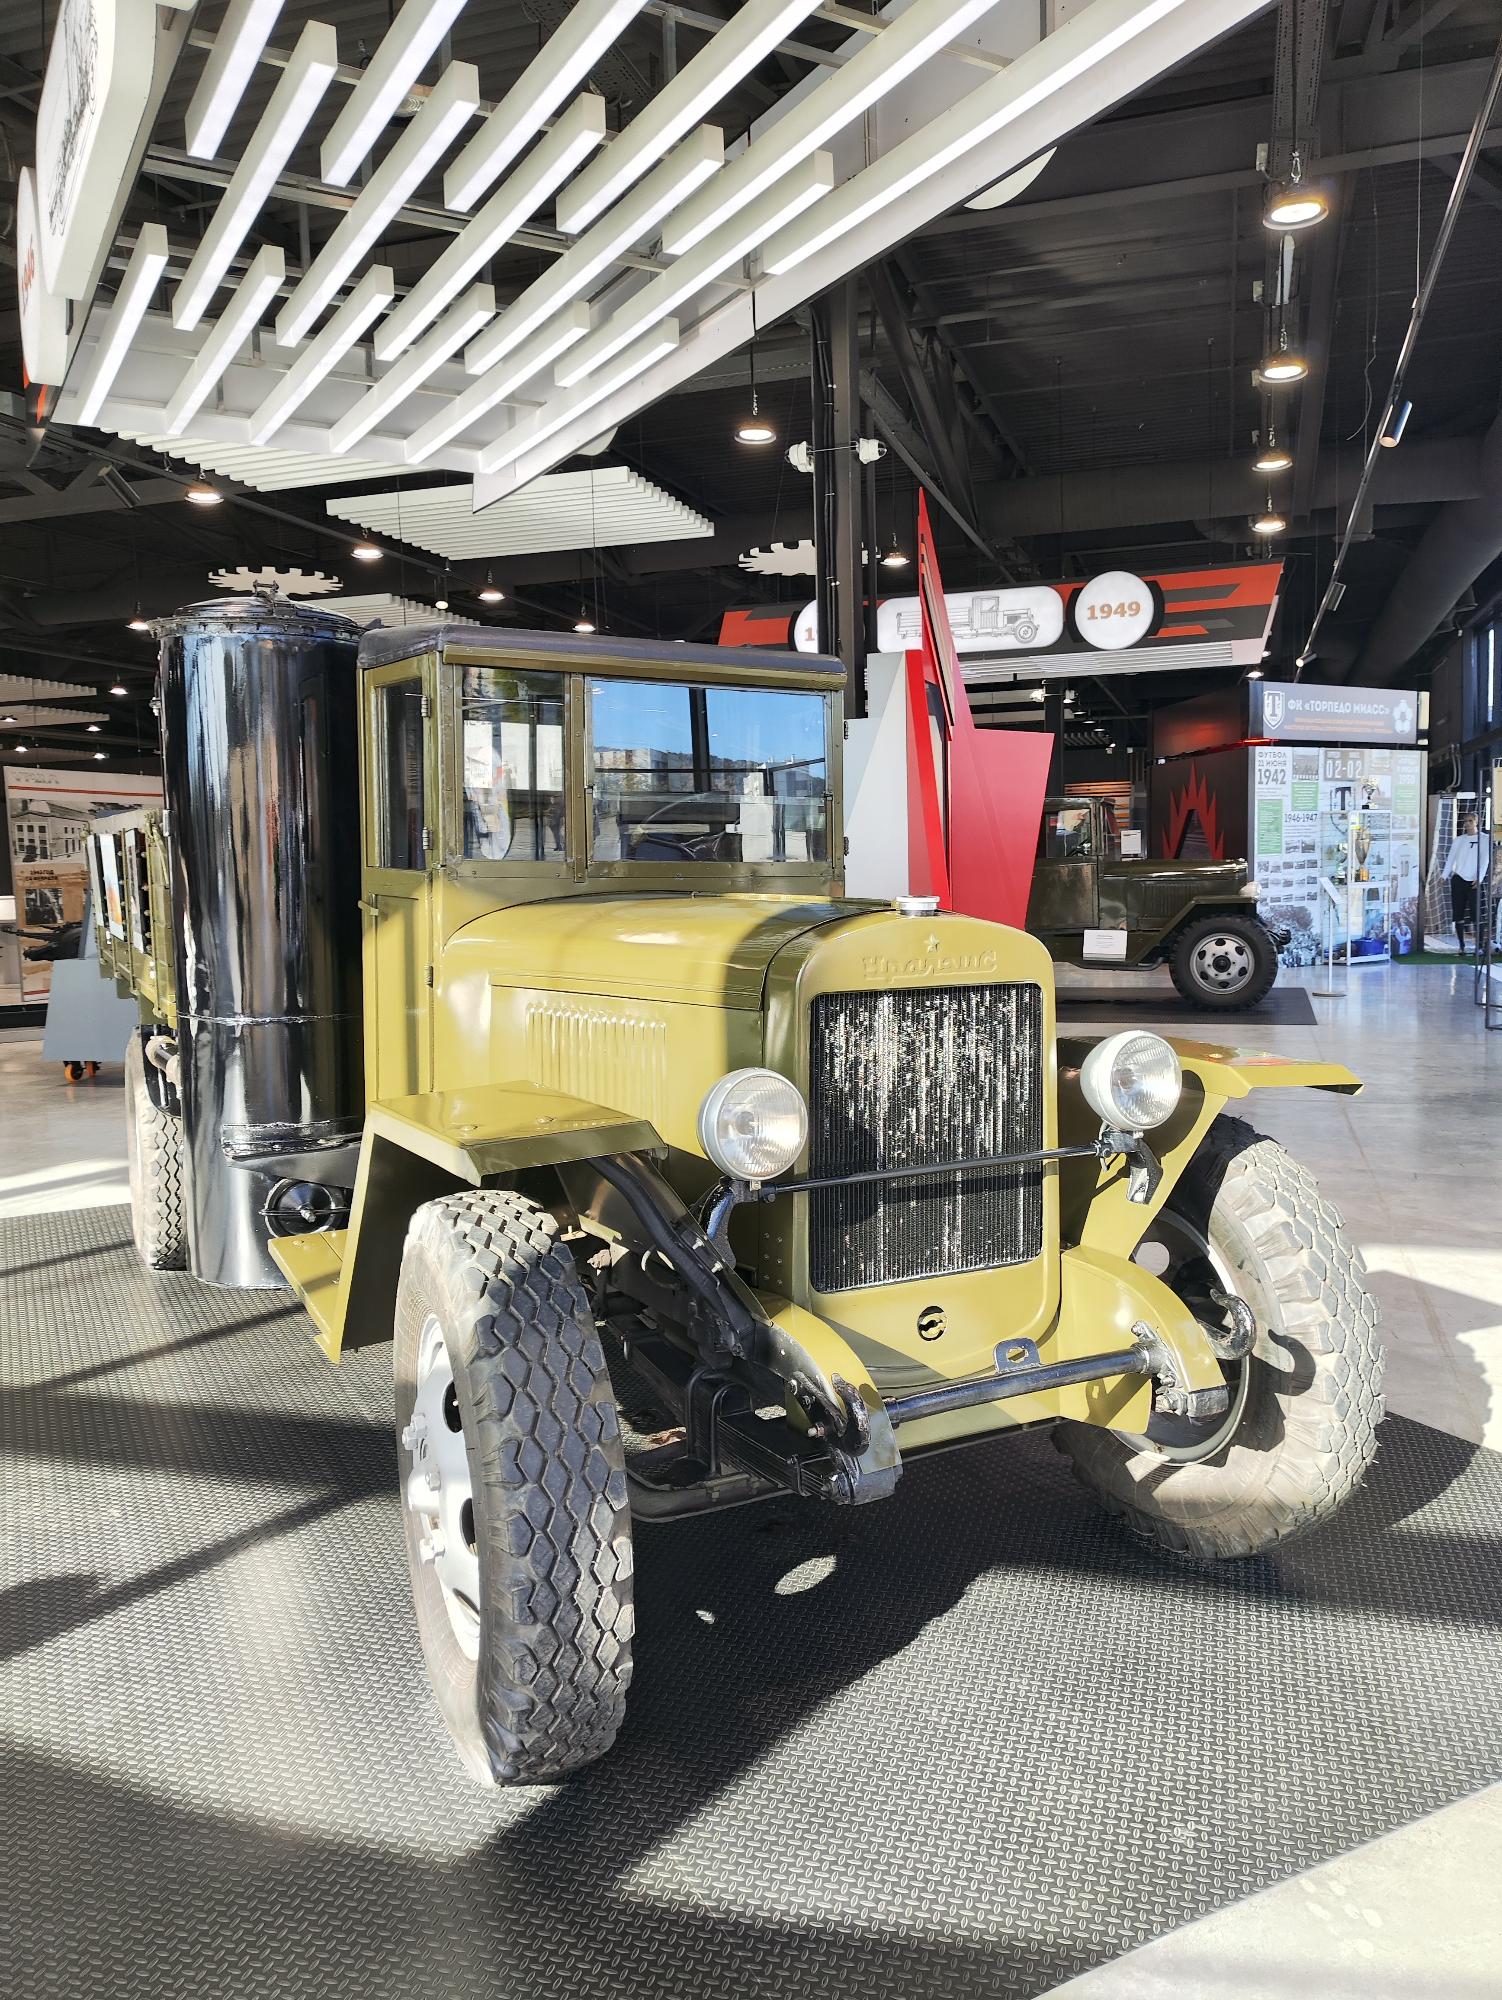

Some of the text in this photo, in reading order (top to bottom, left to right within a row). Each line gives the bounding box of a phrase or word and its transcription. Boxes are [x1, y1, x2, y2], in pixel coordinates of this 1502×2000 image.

[1087, 601, 1141, 620] 1949
[1287, 699, 1303, 711] ФК
[1257, 768, 1286, 785] 1942
[1284, 813, 1318, 823] 1946-1947
